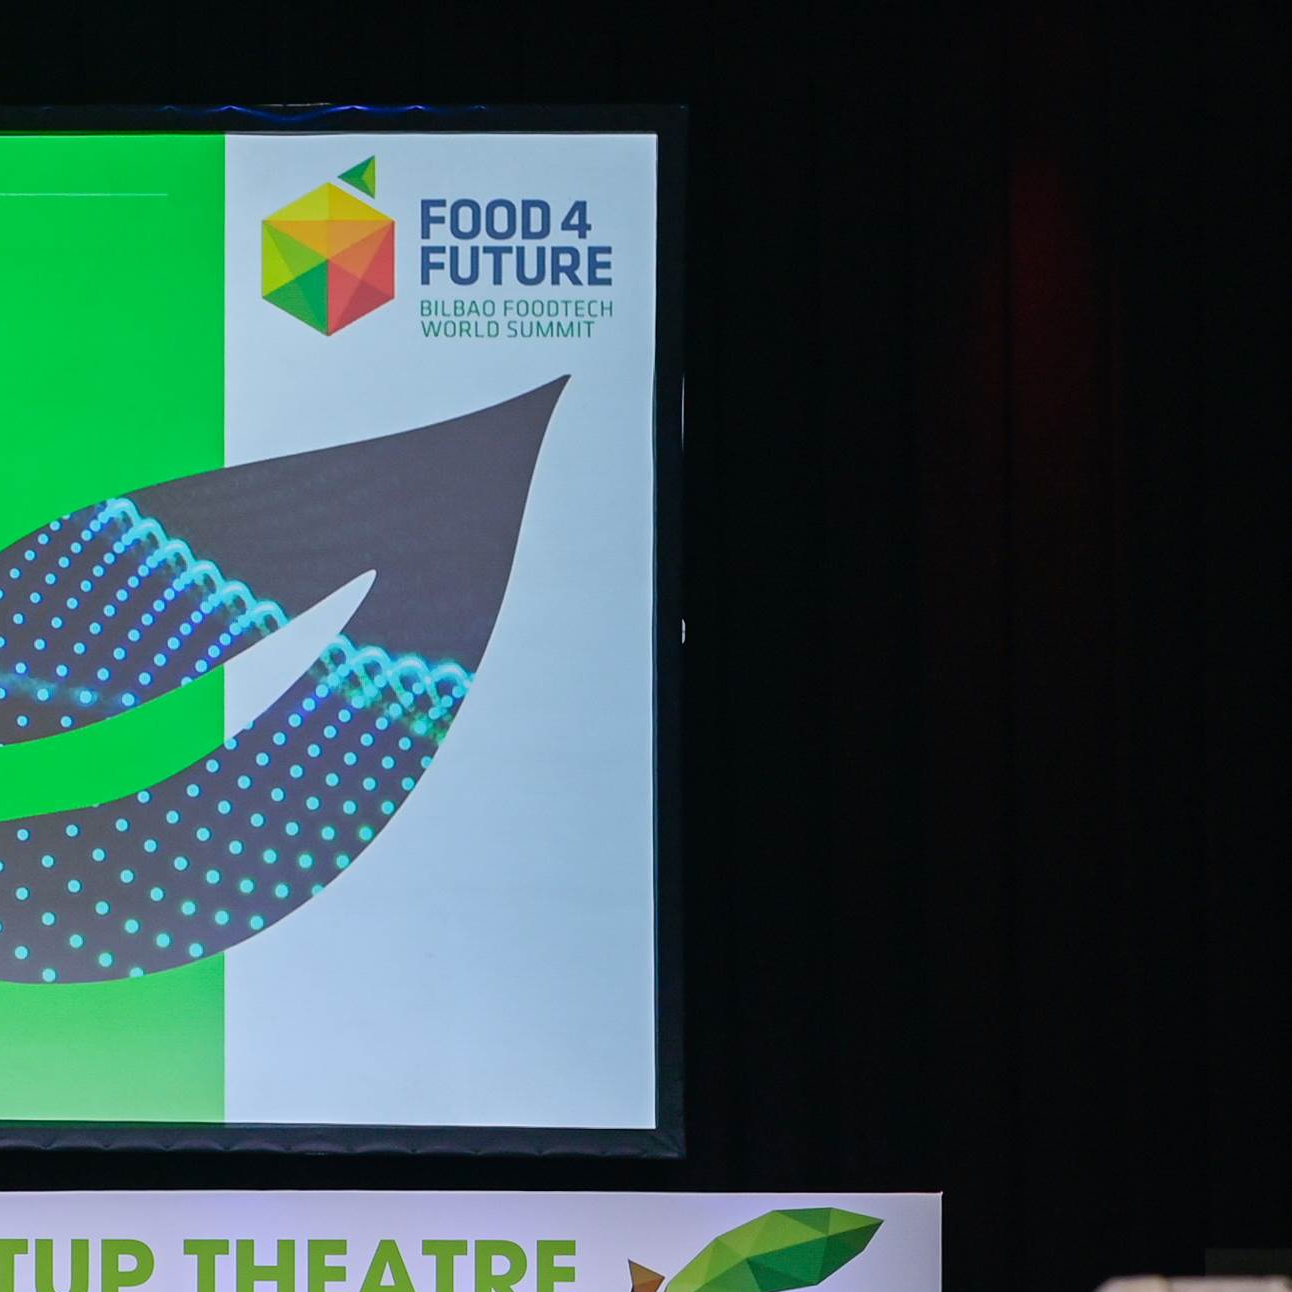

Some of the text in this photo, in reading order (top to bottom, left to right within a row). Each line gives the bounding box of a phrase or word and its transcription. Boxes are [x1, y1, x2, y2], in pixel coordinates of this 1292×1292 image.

[419, 198, 593, 241] FOOD 4
[419, 245, 614, 287] FUTURE
[419, 299, 614, 319] BILBAO FOODTECH
[420, 320, 596, 339] WORLD SUMMIT
